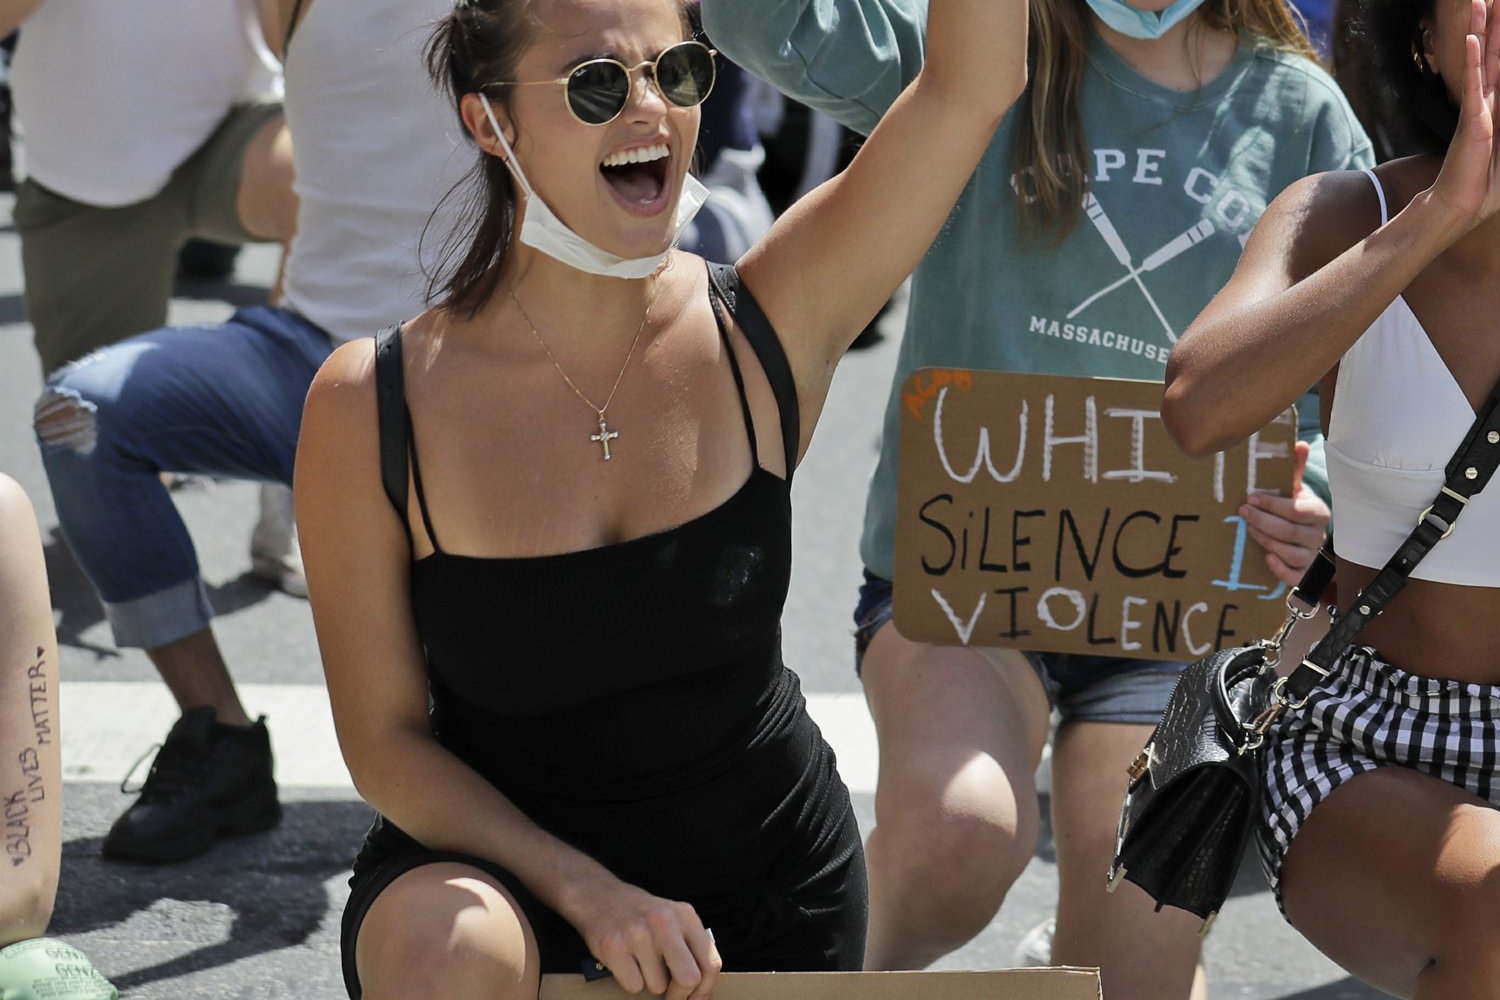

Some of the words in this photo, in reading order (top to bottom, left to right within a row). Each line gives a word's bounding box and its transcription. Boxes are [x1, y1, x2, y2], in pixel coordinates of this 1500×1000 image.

[1183, 166, 1254, 250] CO
[1028, 315, 1174, 364] MASSACHUSE
[27, 660, 52, 746] MATTER
[18, 746, 45, 802] LIVES
